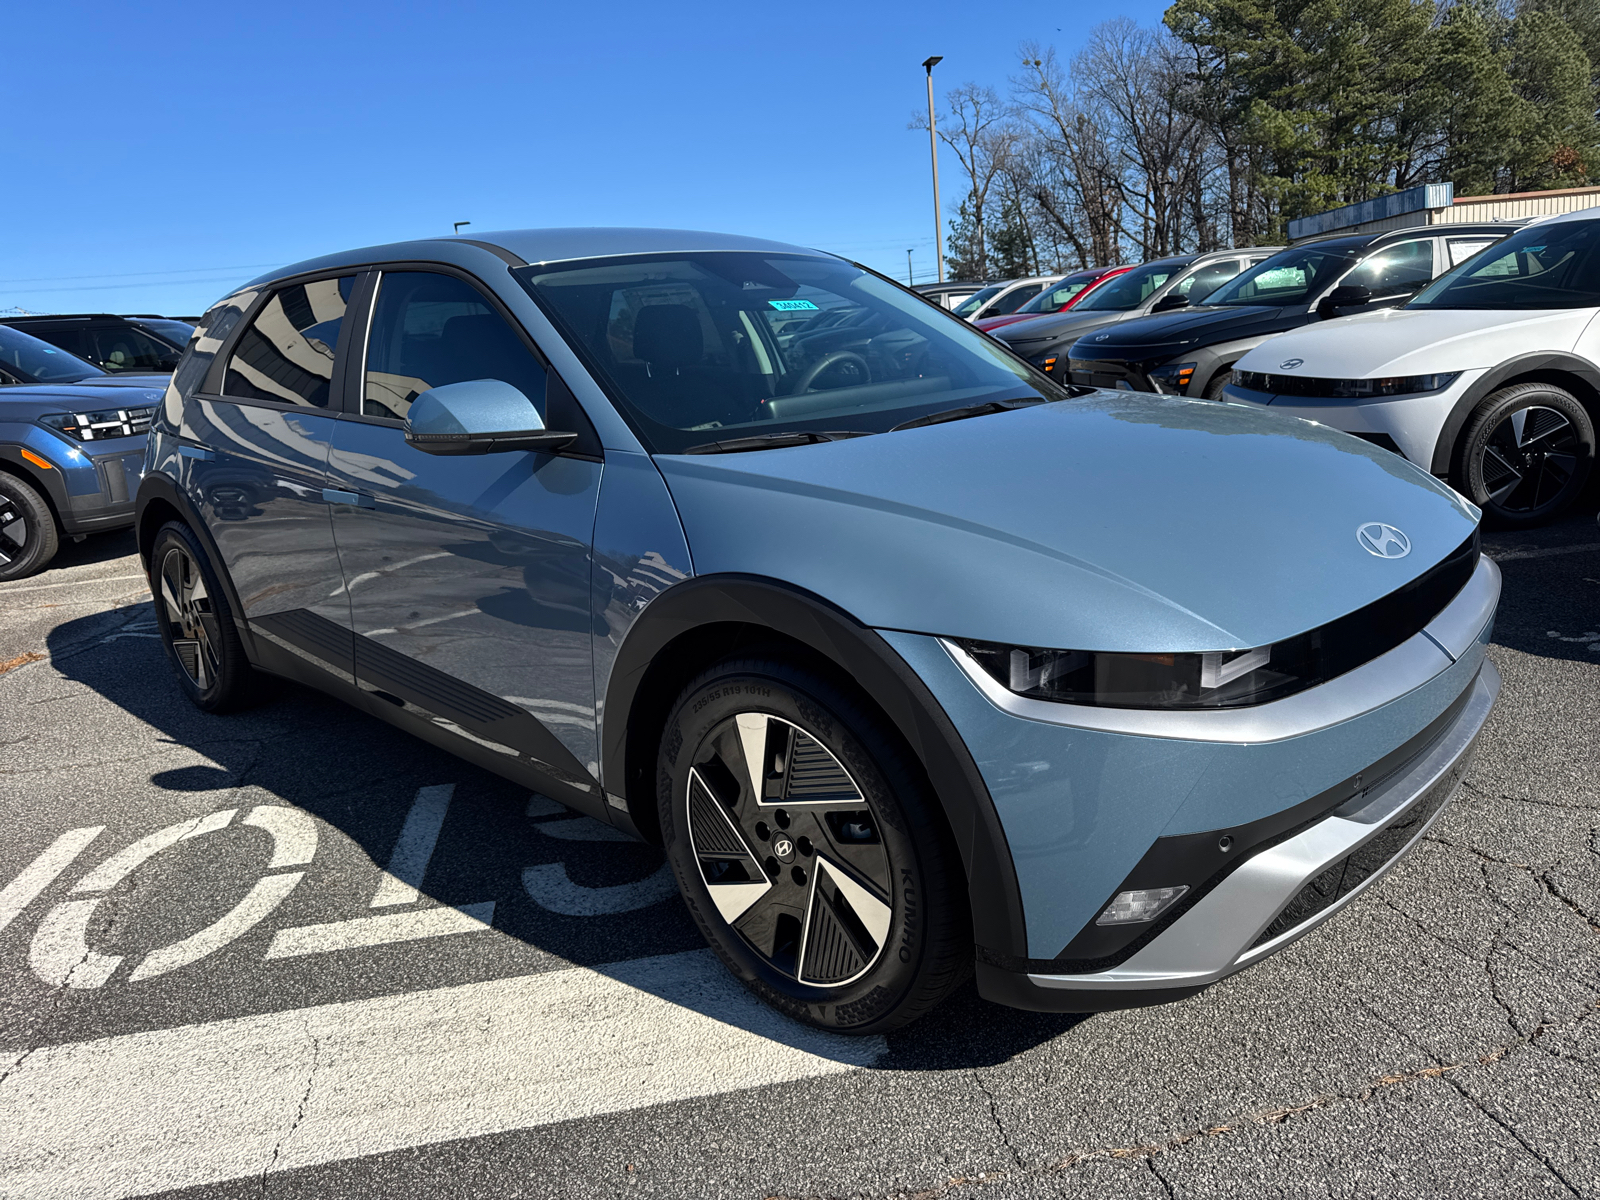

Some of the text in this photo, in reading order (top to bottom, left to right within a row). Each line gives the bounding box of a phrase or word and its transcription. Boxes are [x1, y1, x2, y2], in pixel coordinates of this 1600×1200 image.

[692, 685, 771, 714] 235/55 R19 101H
[898, 868, 917, 964] KUMHO
